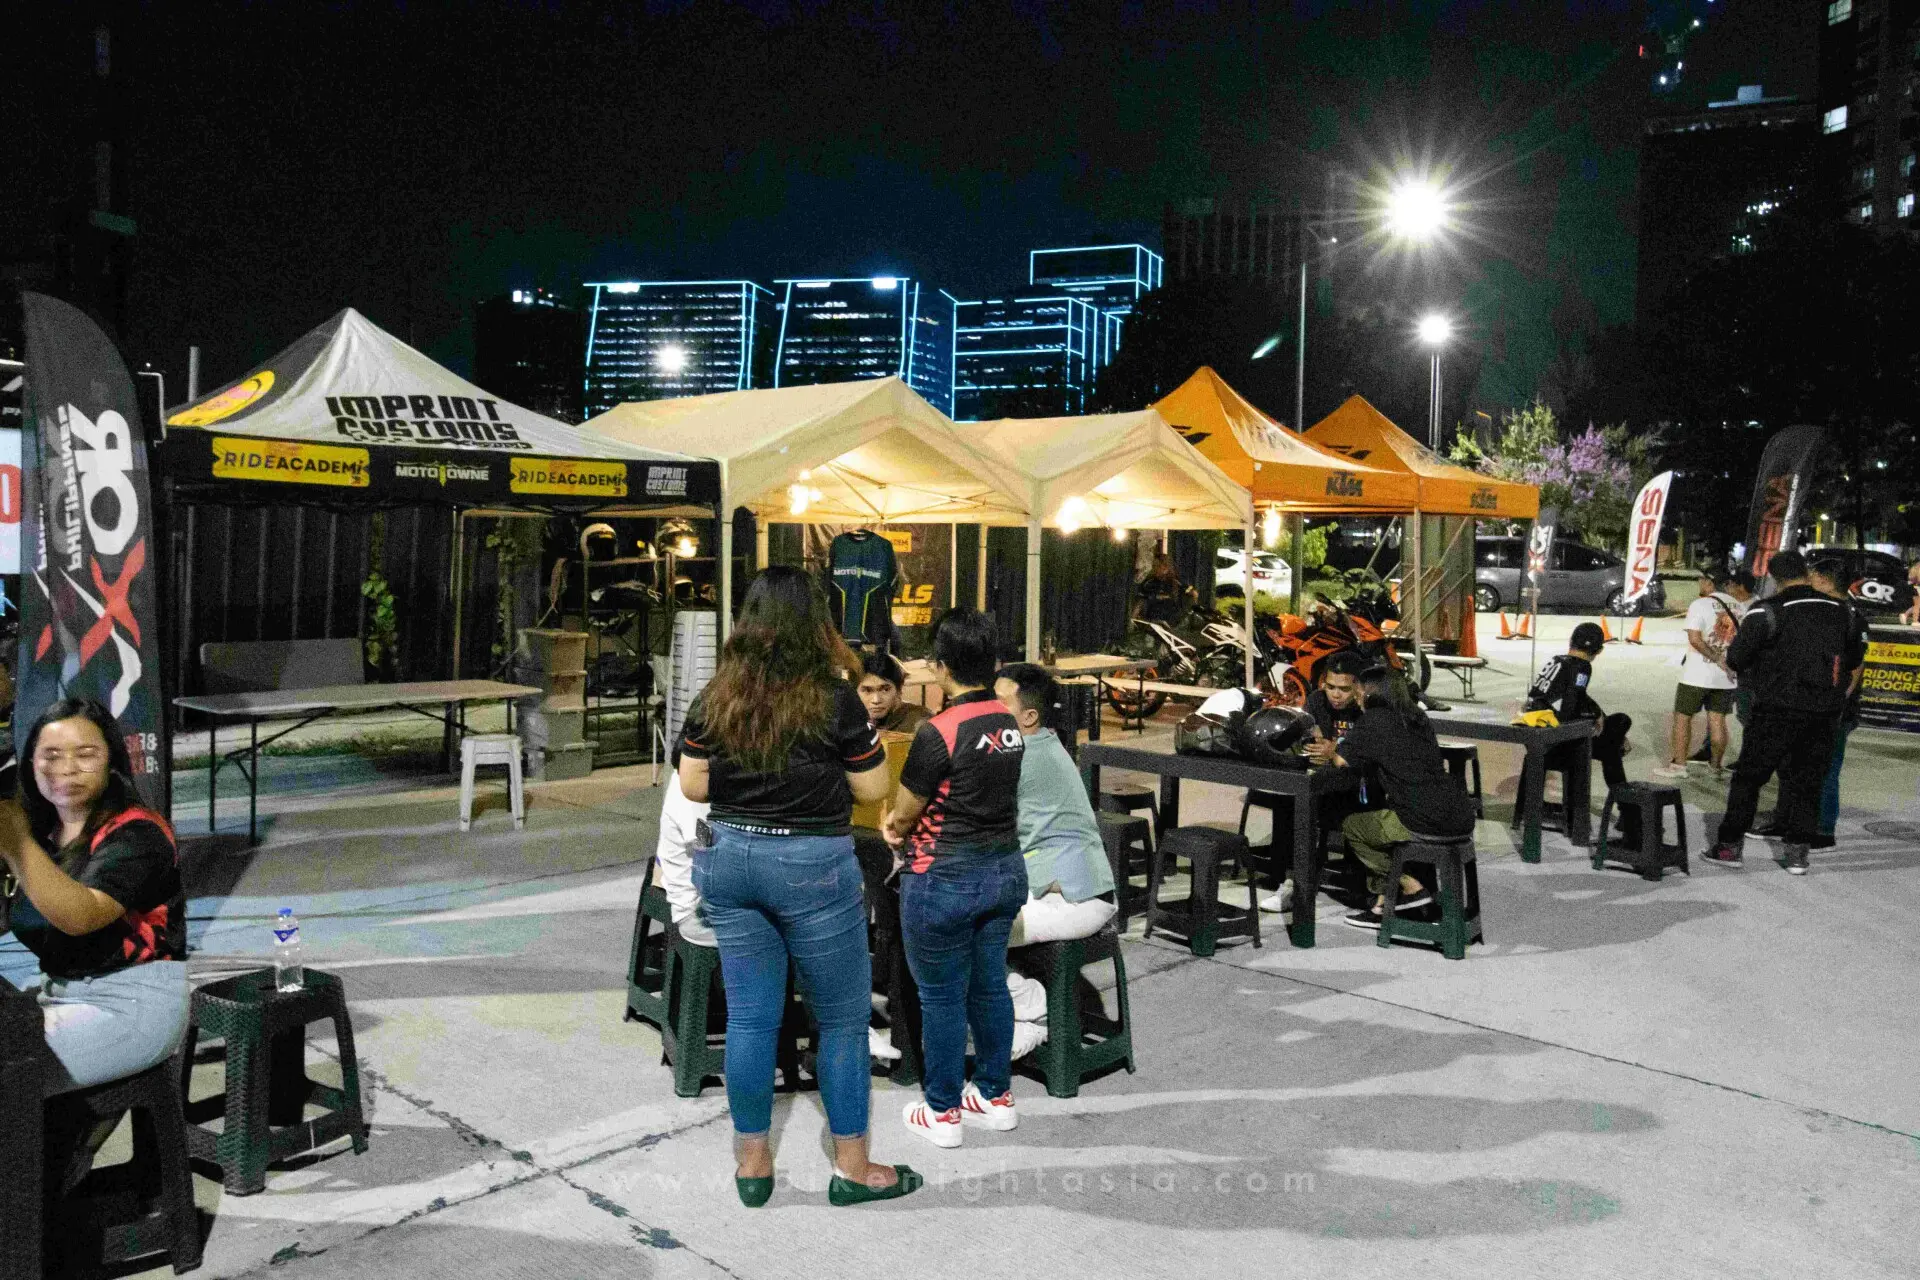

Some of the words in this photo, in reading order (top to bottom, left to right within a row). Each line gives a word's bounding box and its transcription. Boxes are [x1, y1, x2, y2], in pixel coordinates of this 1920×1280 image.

[325, 395, 500, 421] IMPRINT
[335, 417, 520, 441] CUSTOMS
[1325, 471, 1364, 497] KTM
[1470, 486, 1498, 510] KTM
[1628, 487, 1664, 598] SENA
[1863, 668, 1914, 682] RIDING
